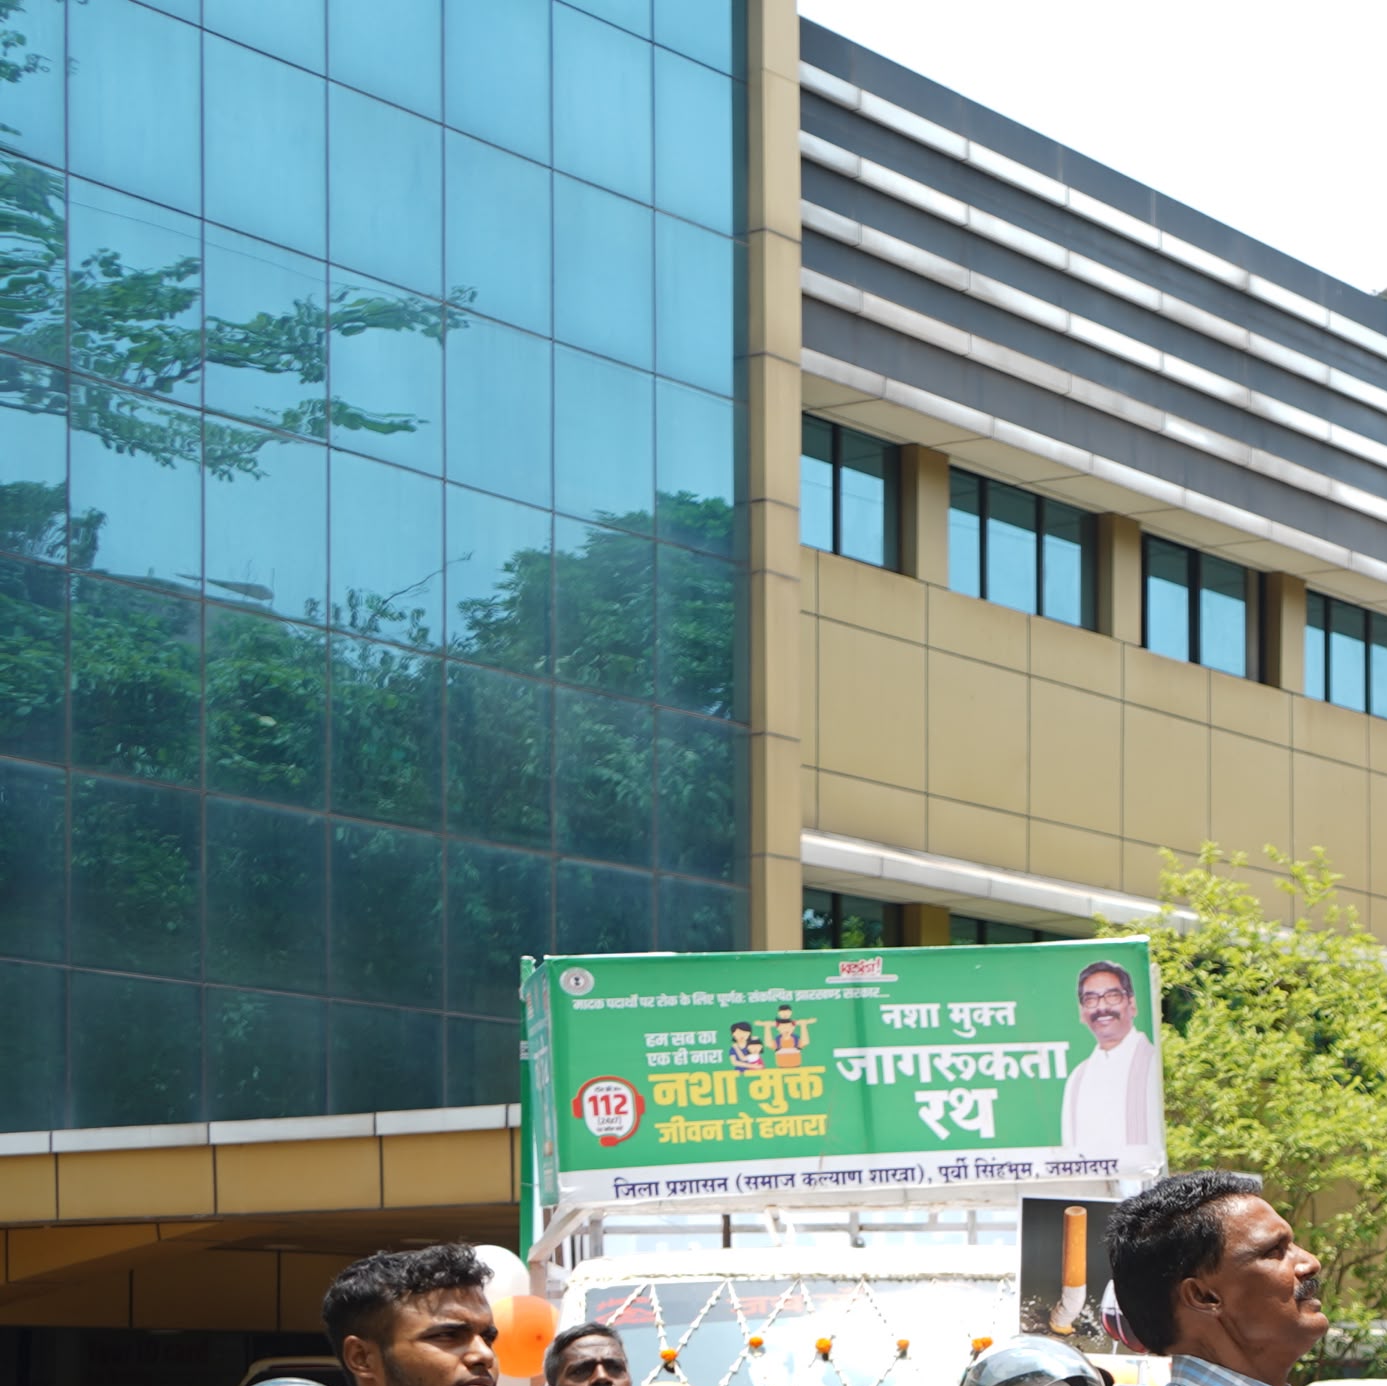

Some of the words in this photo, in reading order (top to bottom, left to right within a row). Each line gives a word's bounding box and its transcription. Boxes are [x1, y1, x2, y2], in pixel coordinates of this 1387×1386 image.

[880, 1003, 941, 1029] नशा
[948, 1001, 1017, 1038] मुक्त
[645, 1032, 668, 1048] हम
[671, 1031, 695, 1047] सब
[698, 1029, 718, 1046] का
[646, 1051, 670, 1067] एक
[673, 1048, 688, 1066] ही
[690, 1049, 724, 1066] नारा
[833, 1042, 1070, 1086] जागरूकता
[588, 1094, 628, 1116] 112
[648, 1070, 740, 1107] नशा
[744, 1066, 826, 1114] मुक्त
[654, 1114, 724, 1144] जीवन
[727, 1112, 754, 1140] हो
[757, 1113, 828, 1138] हमारा
[915, 1088, 999, 1140] रथ
[614, 1177, 660, 1199] जिला
[666, 1178, 728, 1197] प्रशासन
[736, 1173, 796, 1193] (समाज
[802, 1169, 863, 1188] कल्याण
